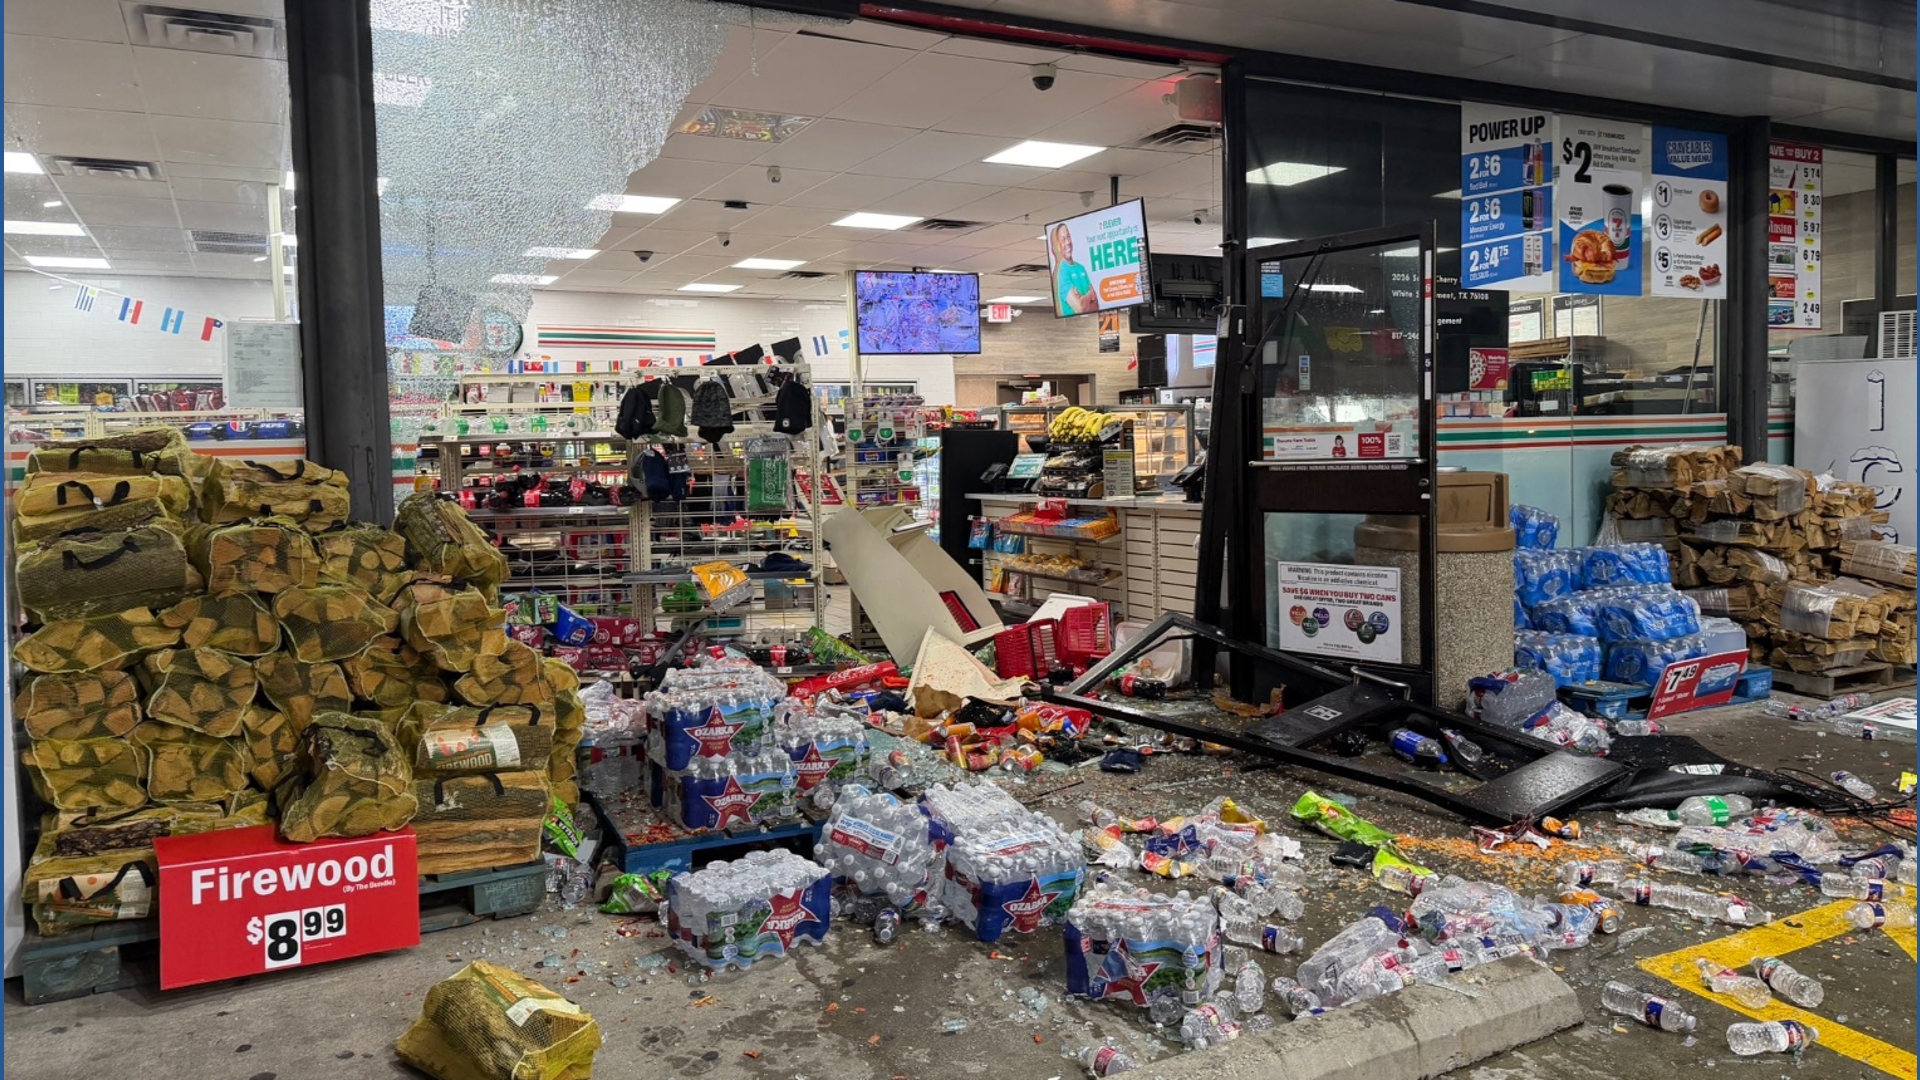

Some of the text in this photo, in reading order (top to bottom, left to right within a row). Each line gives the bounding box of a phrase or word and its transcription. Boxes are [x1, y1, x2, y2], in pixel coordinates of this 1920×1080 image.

[1469, 115, 1546, 143] POWER UP
[1667, 141, 1712, 154] CRAVEABLES
[1769, 145, 1785, 157] AVE
[1795, 148, 1812, 160] BUY
[1813, 150, 1820, 160] 2
[1563, 137, 1592, 184] $2
[1668, 154, 1712, 164] VALUE MENU
[1470, 154, 1501, 179] 2 FOR $6
[1658, 186, 1668, 203] $1
[1470, 198, 1501, 224] 2 FOR $6
[1658, 222, 1668, 236] $3
[1769, 221, 1793, 235] inston
[1470, 250, 1480, 273] 2
[1480, 263, 1490, 271] FOR
[1658, 251, 1669, 268] $5
[1470, 272, 1490, 282] CELSIUS
[1391, 290, 1413, 298] White
[1565, 298, 1588, 306] Lienses
[1437, 318, 1463, 326] gement
[1424, 359, 1431, 367] 5
[1361, 436, 1381, 444] 100%
[1297, 574, 1318, 582] Nicotine
[1324, 569, 1344, 577] product
[1282, 586, 1299, 594] SAVE
[1329, 590, 1344, 598] YOU
[1344, 591, 1358, 599] BUY
[1358, 592, 1375, 600] TWO
[1375, 594, 1396, 602] CANS
[694, 725, 734, 737] OZARKA
[713, 794, 753, 807] OZARKA
[191, 844, 394, 905] Firewood
[343, 878, 396, 893] (By The Bundle)
[1009, 896, 1048, 912] OZARKA
[766, 911, 806, 930] OZARKA
